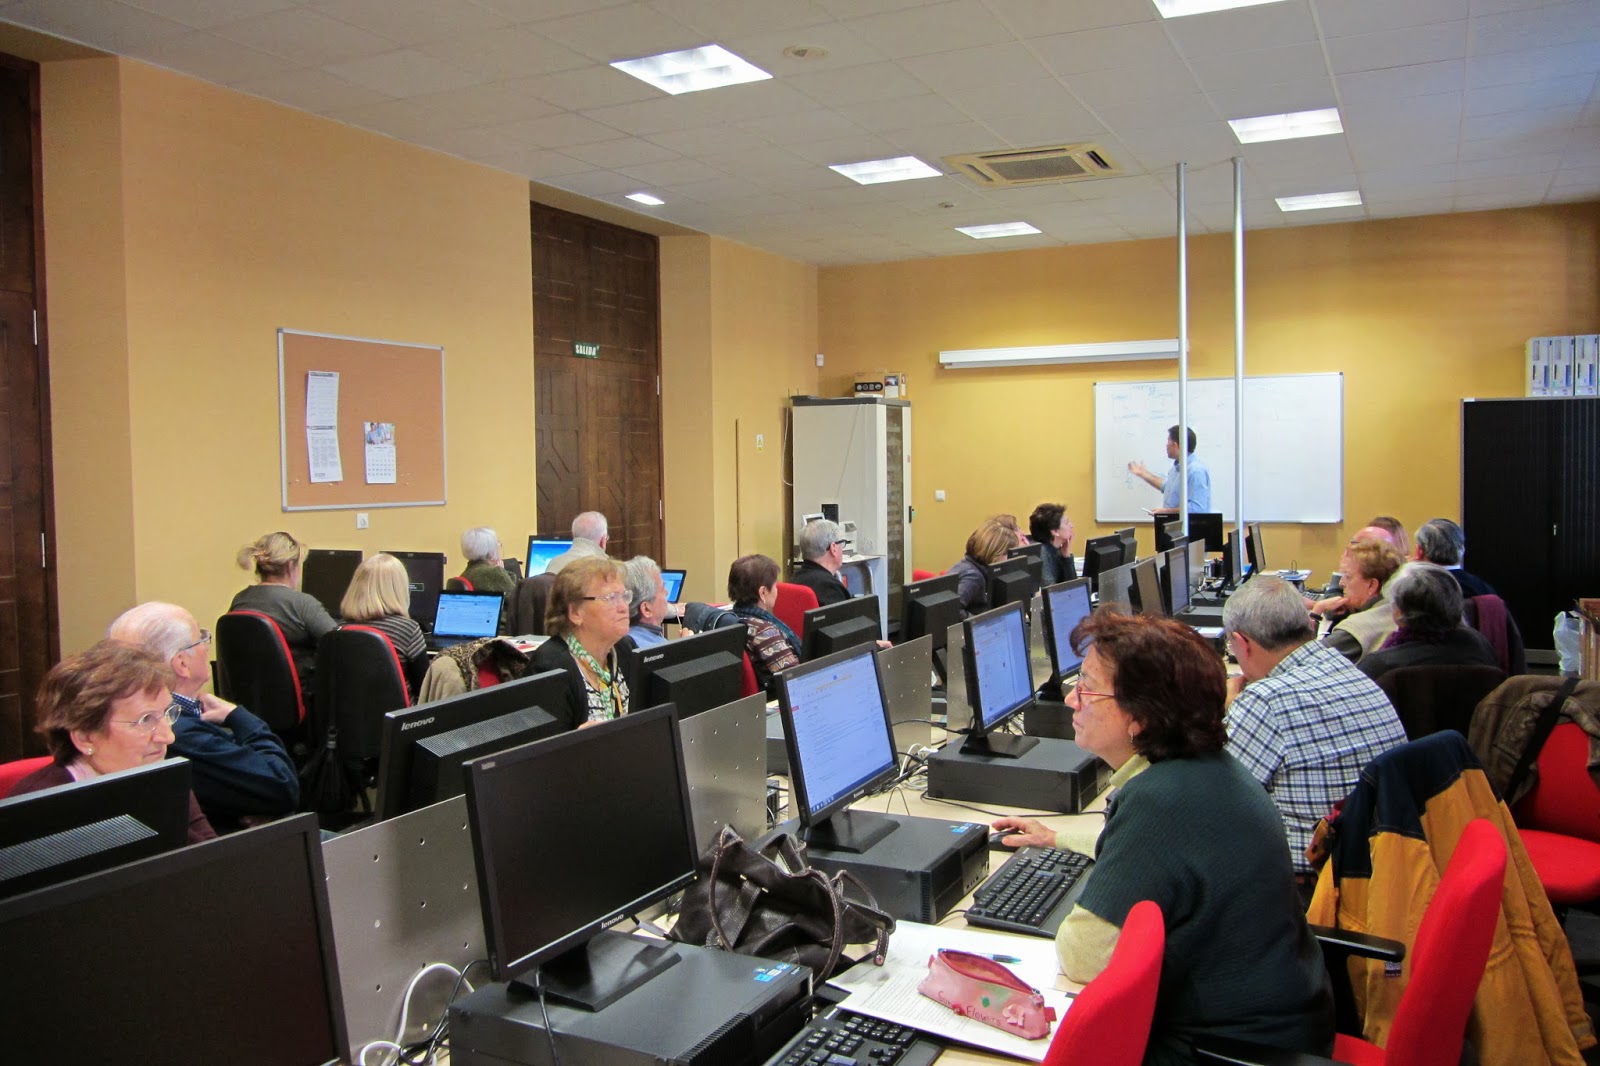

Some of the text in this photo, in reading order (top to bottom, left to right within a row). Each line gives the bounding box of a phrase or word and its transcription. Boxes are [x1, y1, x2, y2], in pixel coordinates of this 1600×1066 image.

[575, 344, 597, 356] SALIDA
[643, 653, 665, 663] lenovo
[401, 716, 436, 731] lenovo
[601, 913, 625, 929] lenovo
